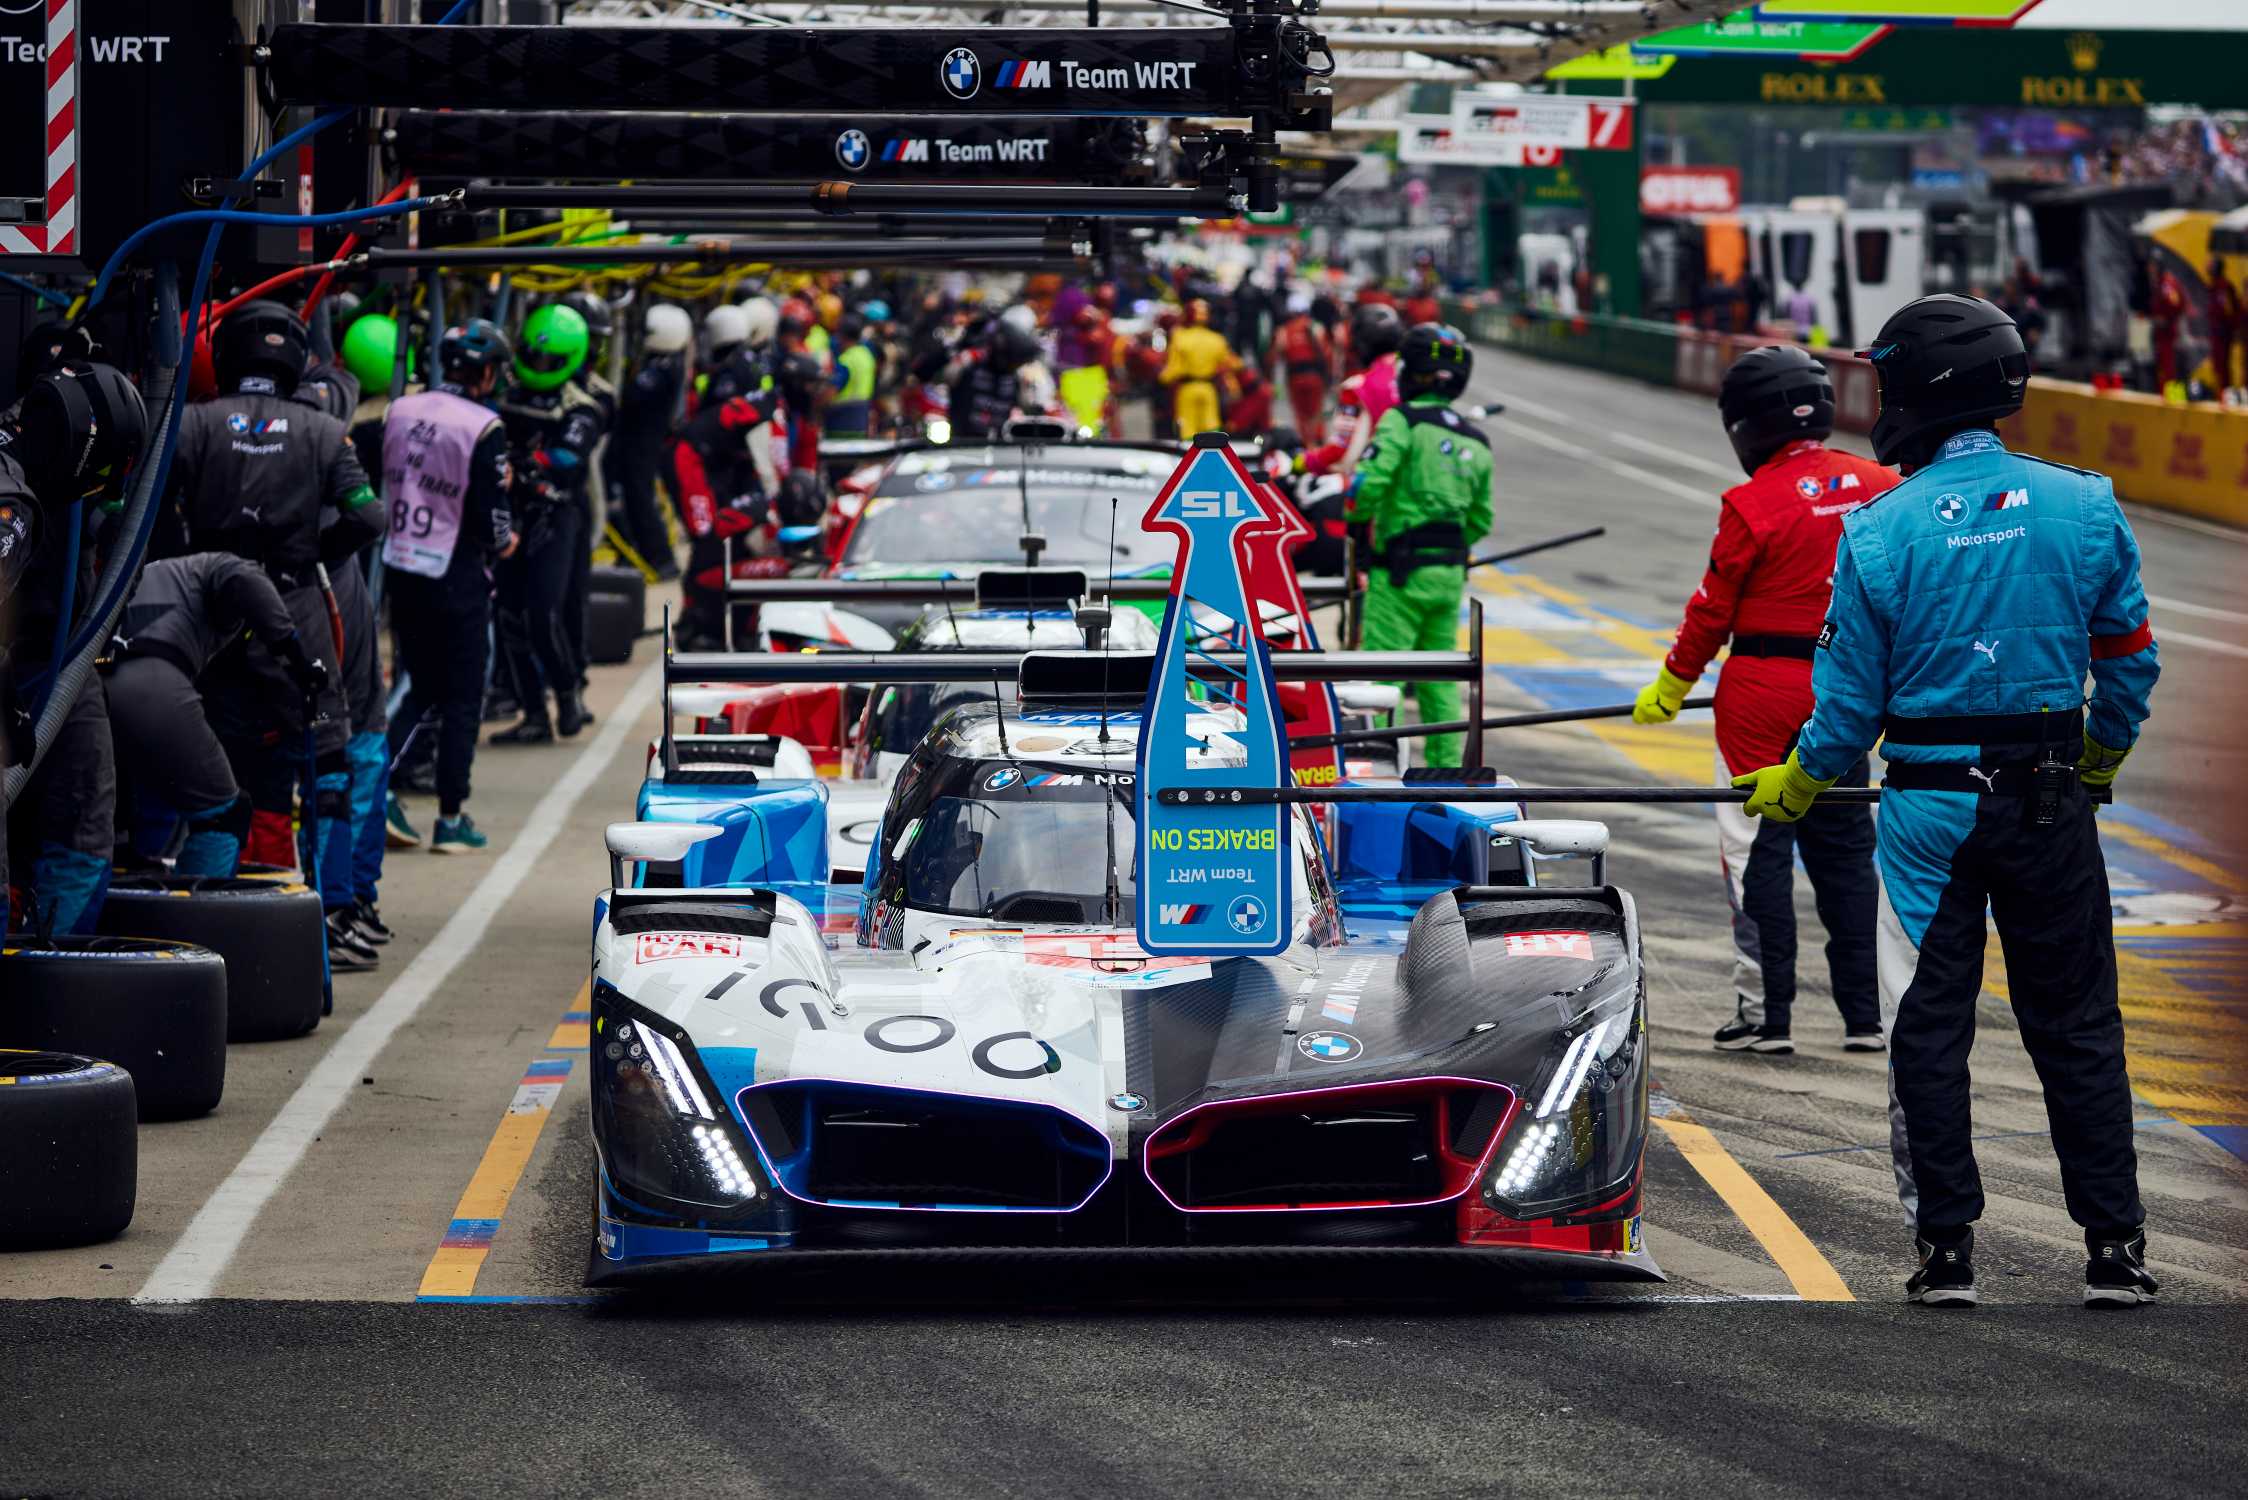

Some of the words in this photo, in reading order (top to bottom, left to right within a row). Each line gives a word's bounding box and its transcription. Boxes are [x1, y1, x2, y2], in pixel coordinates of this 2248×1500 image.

[90, 36, 170, 62] WRT
[1060, 60, 1129, 89] Team
[1134, 61, 1196, 89] WRT
[1761, 73, 1884, 103] ROLEX
[2021, 77, 2145, 106] ROLEX
[1593, 104, 1624, 147] 7
[934, 139, 993, 162] Team
[996, 139, 1049, 162] WRT
[391, 499, 434, 539] 89
[1946, 525, 2026, 549] Motorsport
[1151, 828, 1183, 851] ON
[1188, 828, 1276, 851] BRAKES
[1166, 866, 1208, 883] WRT
[1210, 867, 1256, 883] Team
